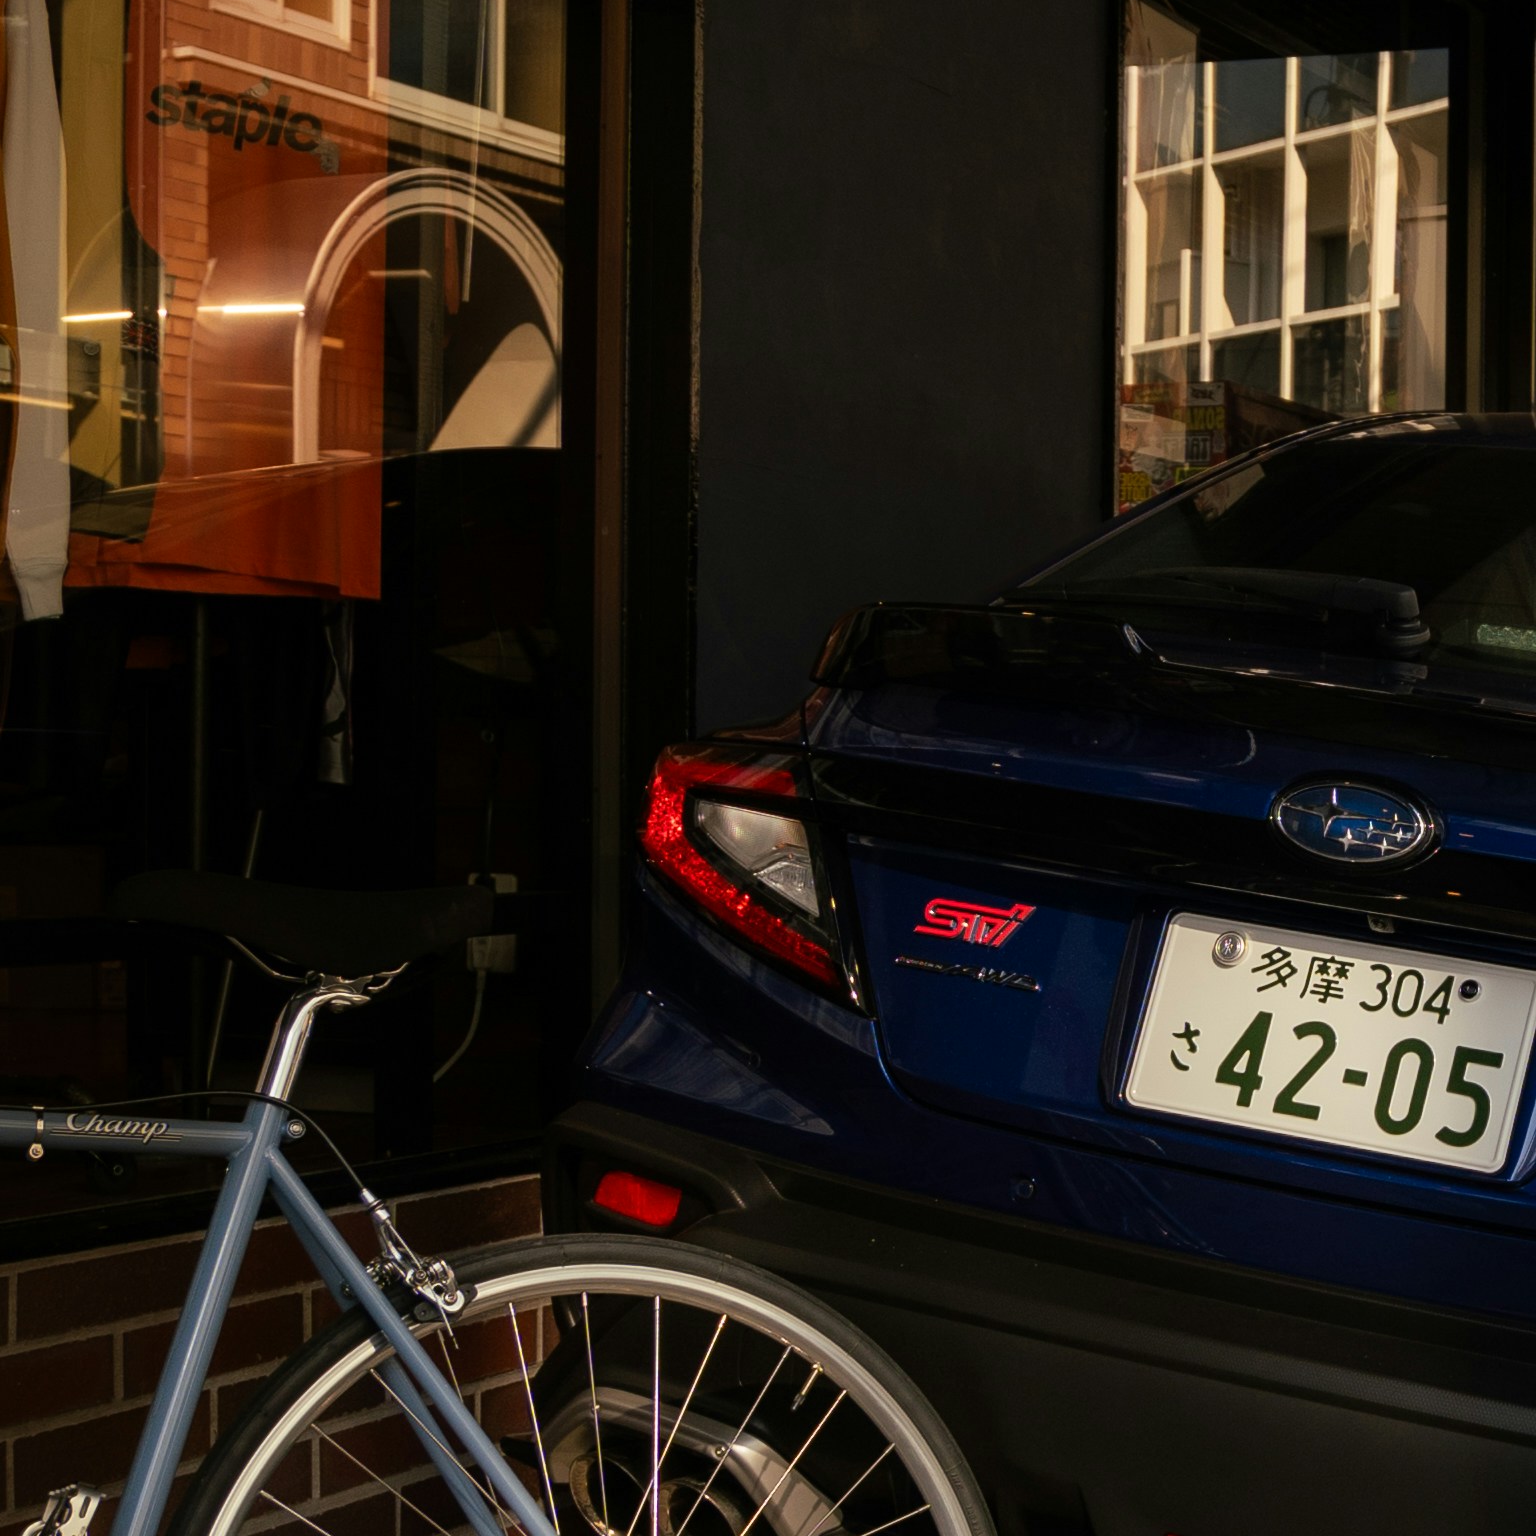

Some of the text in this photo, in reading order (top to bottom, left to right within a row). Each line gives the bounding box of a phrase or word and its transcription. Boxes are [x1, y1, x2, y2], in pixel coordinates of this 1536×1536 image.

[146, 81, 323, 152] staple
[1251, 946, 1455, 1025] 多摩 304
[1170, 1011, 1504, 1148] さ 42-05
[66, 1113, 169, 1144] Champ
